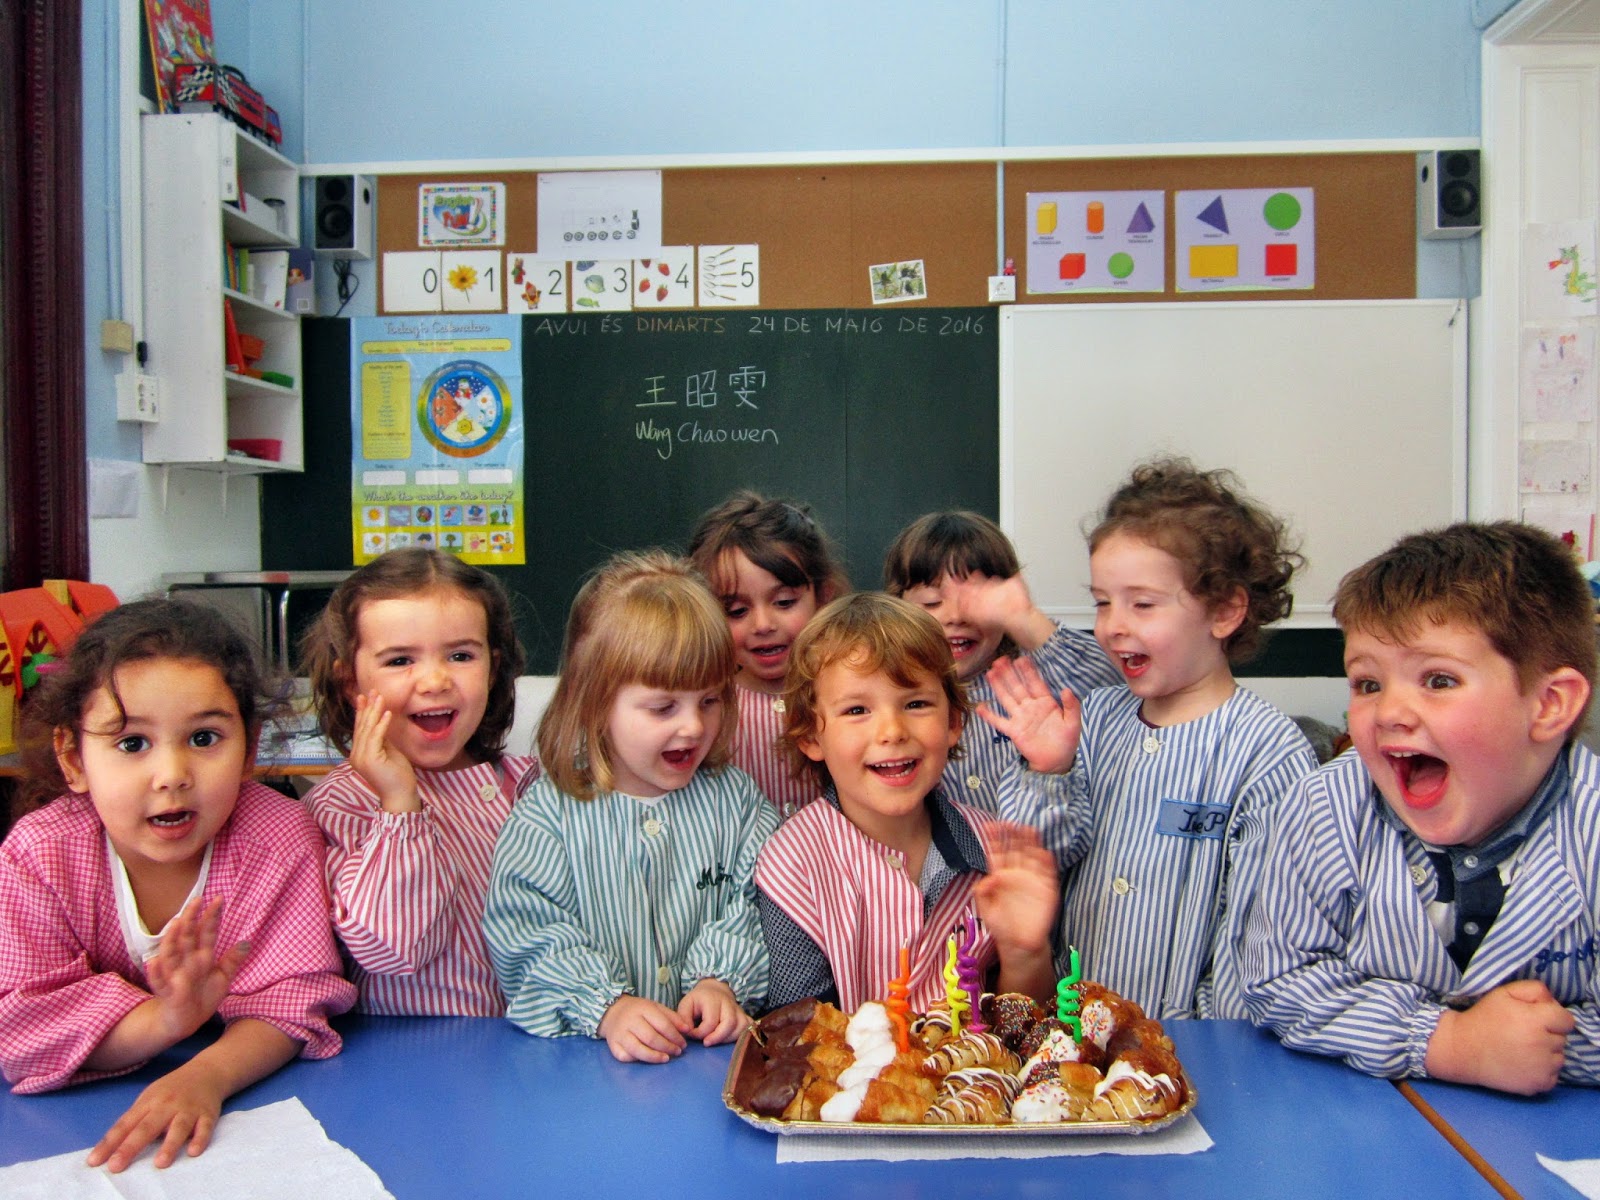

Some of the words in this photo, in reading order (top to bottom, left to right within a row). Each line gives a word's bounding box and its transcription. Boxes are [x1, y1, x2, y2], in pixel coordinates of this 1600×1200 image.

[422, 268, 438, 294] 0
[483, 267, 495, 292] 1
[548, 270, 563, 295] 2
[613, 267, 628, 293] 3
[674, 263, 690, 289] 4
[739, 262, 755, 288] 5
[534, 317, 587, 336] AVUI
[600, 314, 622, 333] ÉS
[637, 316, 726, 334] DIMARTS
[748, 316, 775, 333] 24
[784, 316, 811, 333] DE
[825, 316, 884, 333] MAIG
[898, 316, 928, 333] DE
[938, 314, 985, 335] 2016
[635, 418, 673, 460] Wang
